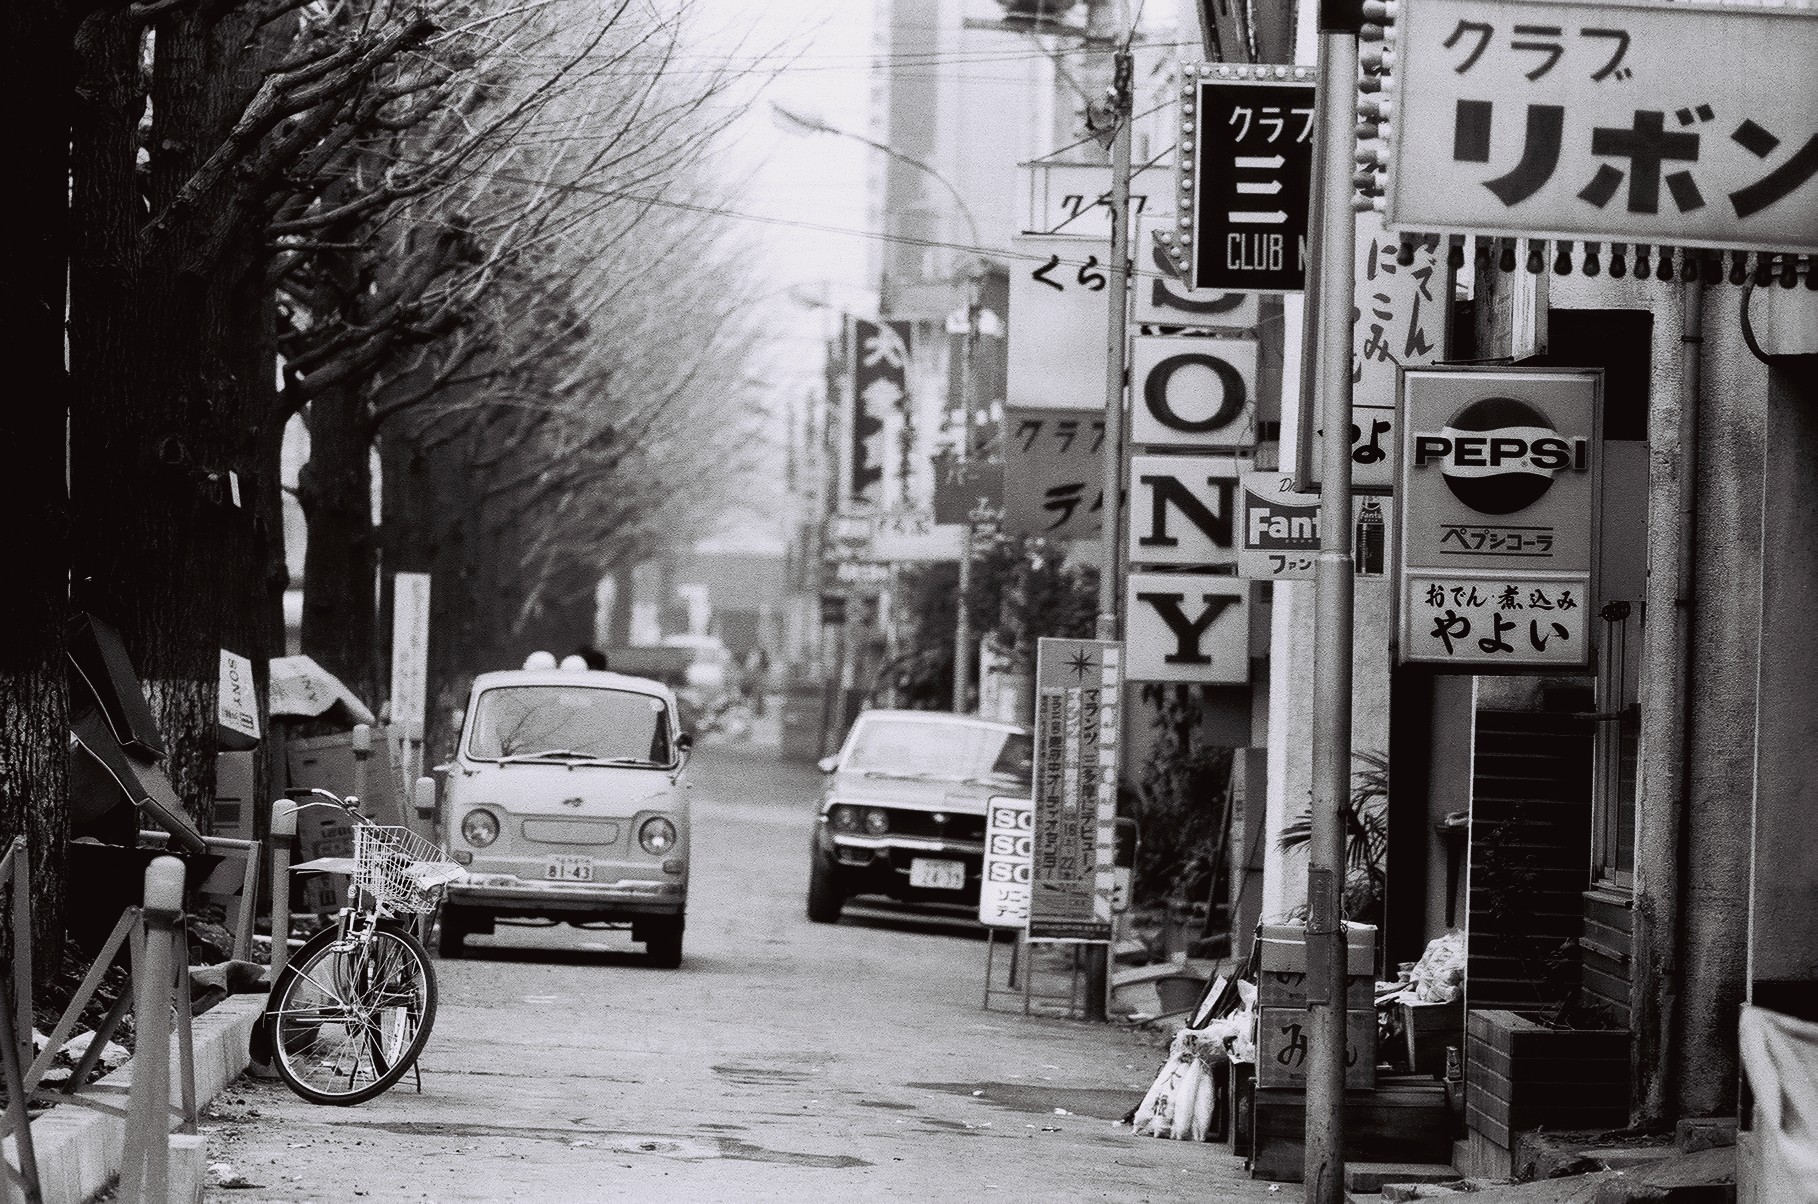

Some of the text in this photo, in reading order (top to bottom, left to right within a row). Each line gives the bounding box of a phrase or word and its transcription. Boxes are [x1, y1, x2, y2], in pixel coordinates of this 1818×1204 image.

[1444, 19, 1633, 82] クラブ
[1453, 99, 1818, 218] リボン
[1227, 232, 1284, 271] CLUB
[1415, 436, 1587, 470] PEPSI
[1249, 507, 1322, 545] Fant
[1440, 528, 1553, 551] ペプシコーラ
[1268, 554, 1313, 575] ファン
[1430, 609, 1570, 656] やよい
[993, 808, 1032, 831] SO
[991, 835, 1031, 858] SO
[989, 861, 1030, 884] SO
